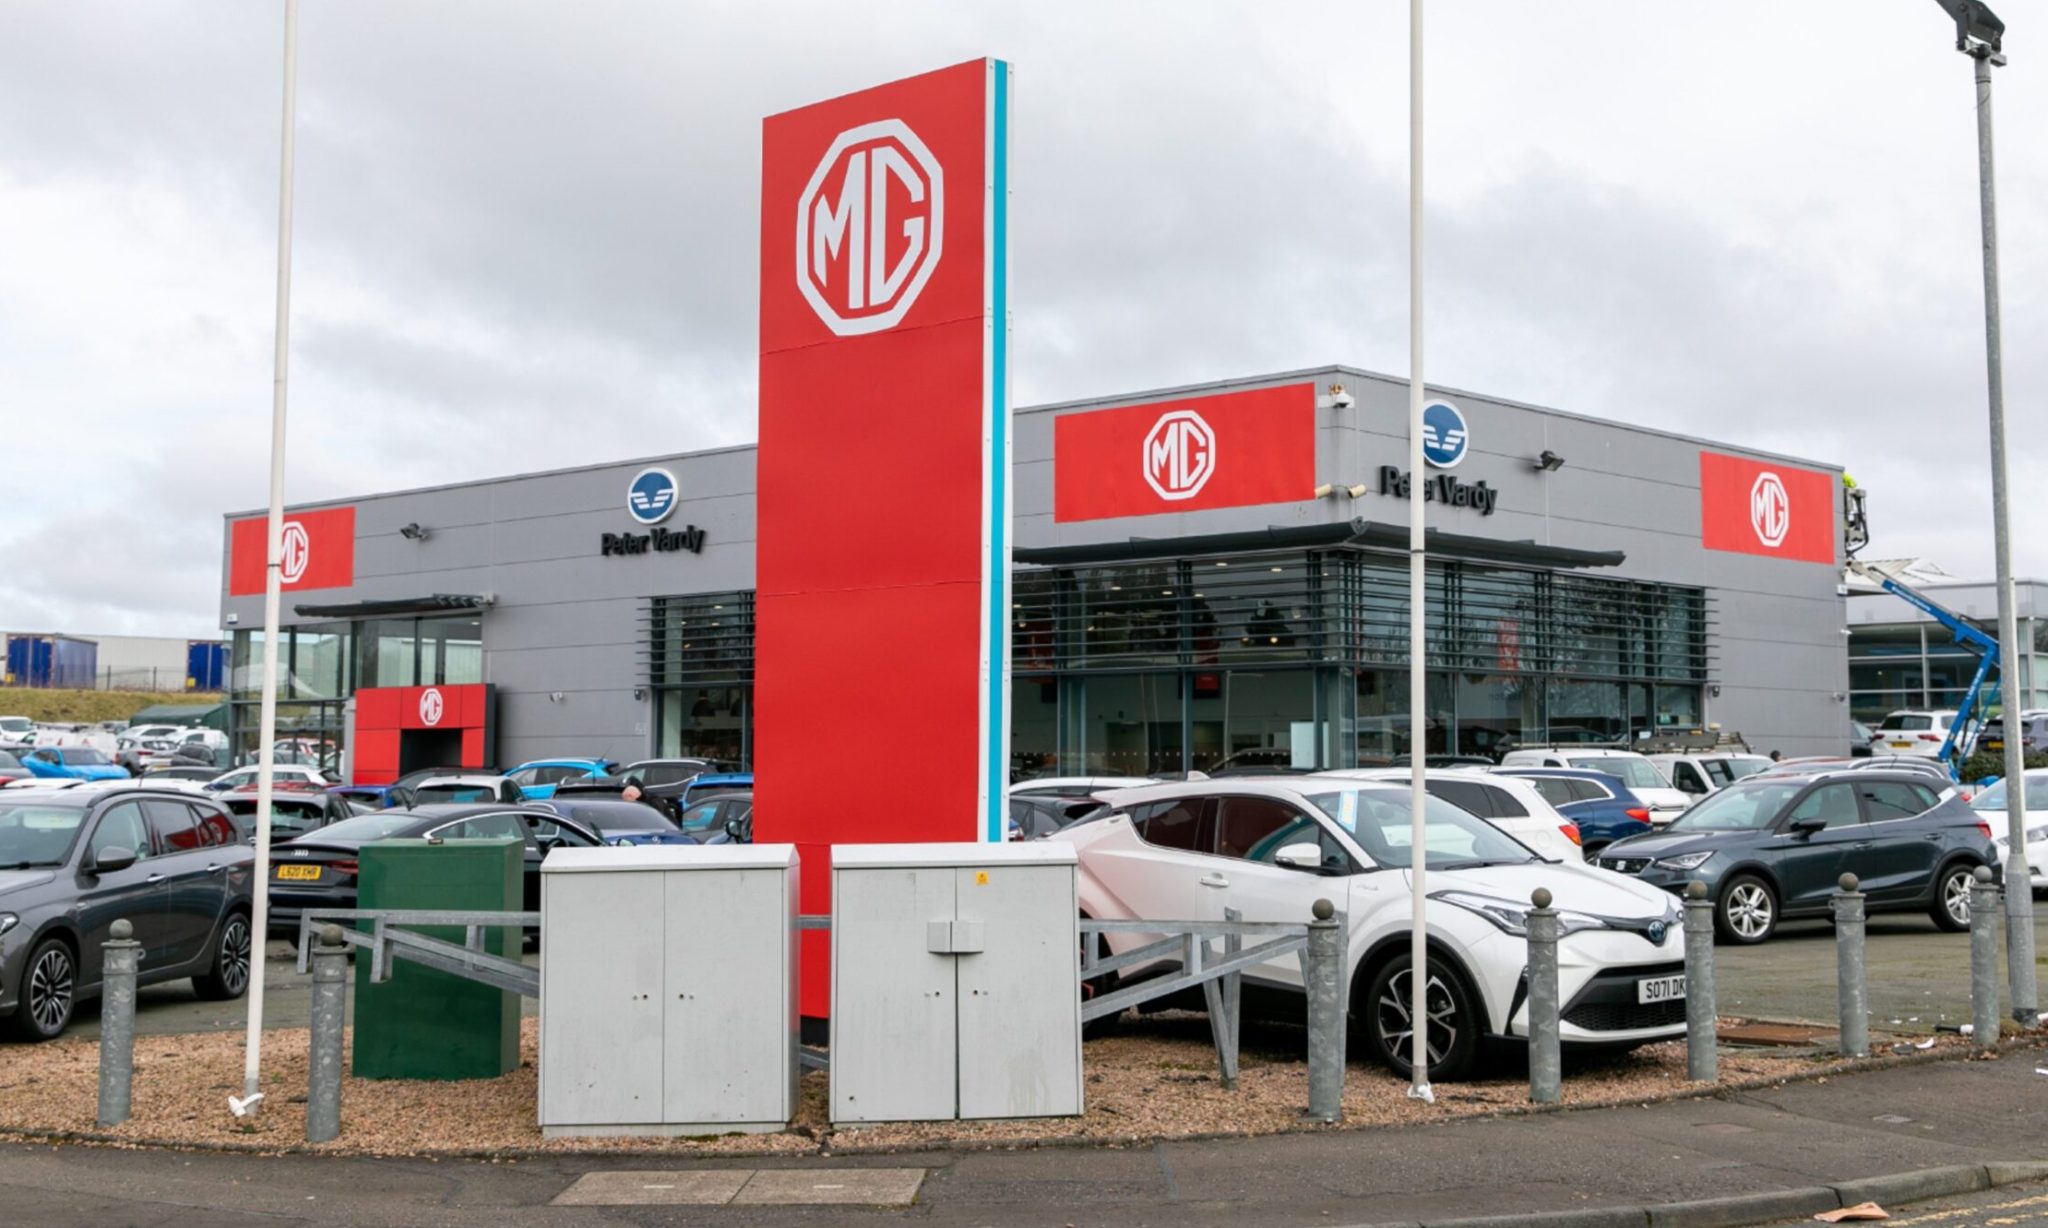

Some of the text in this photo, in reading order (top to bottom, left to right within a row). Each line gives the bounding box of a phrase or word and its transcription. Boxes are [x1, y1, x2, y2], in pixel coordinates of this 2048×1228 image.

[811, 143, 927, 311] MG
[1151, 420, 1207, 490] MG
[1379, 465, 1498, 516] Peer Vardy
[1755, 480, 1785, 538] MG
[601, 525, 706, 556] Peter Vardy
[421, 692, 441, 722] MG
